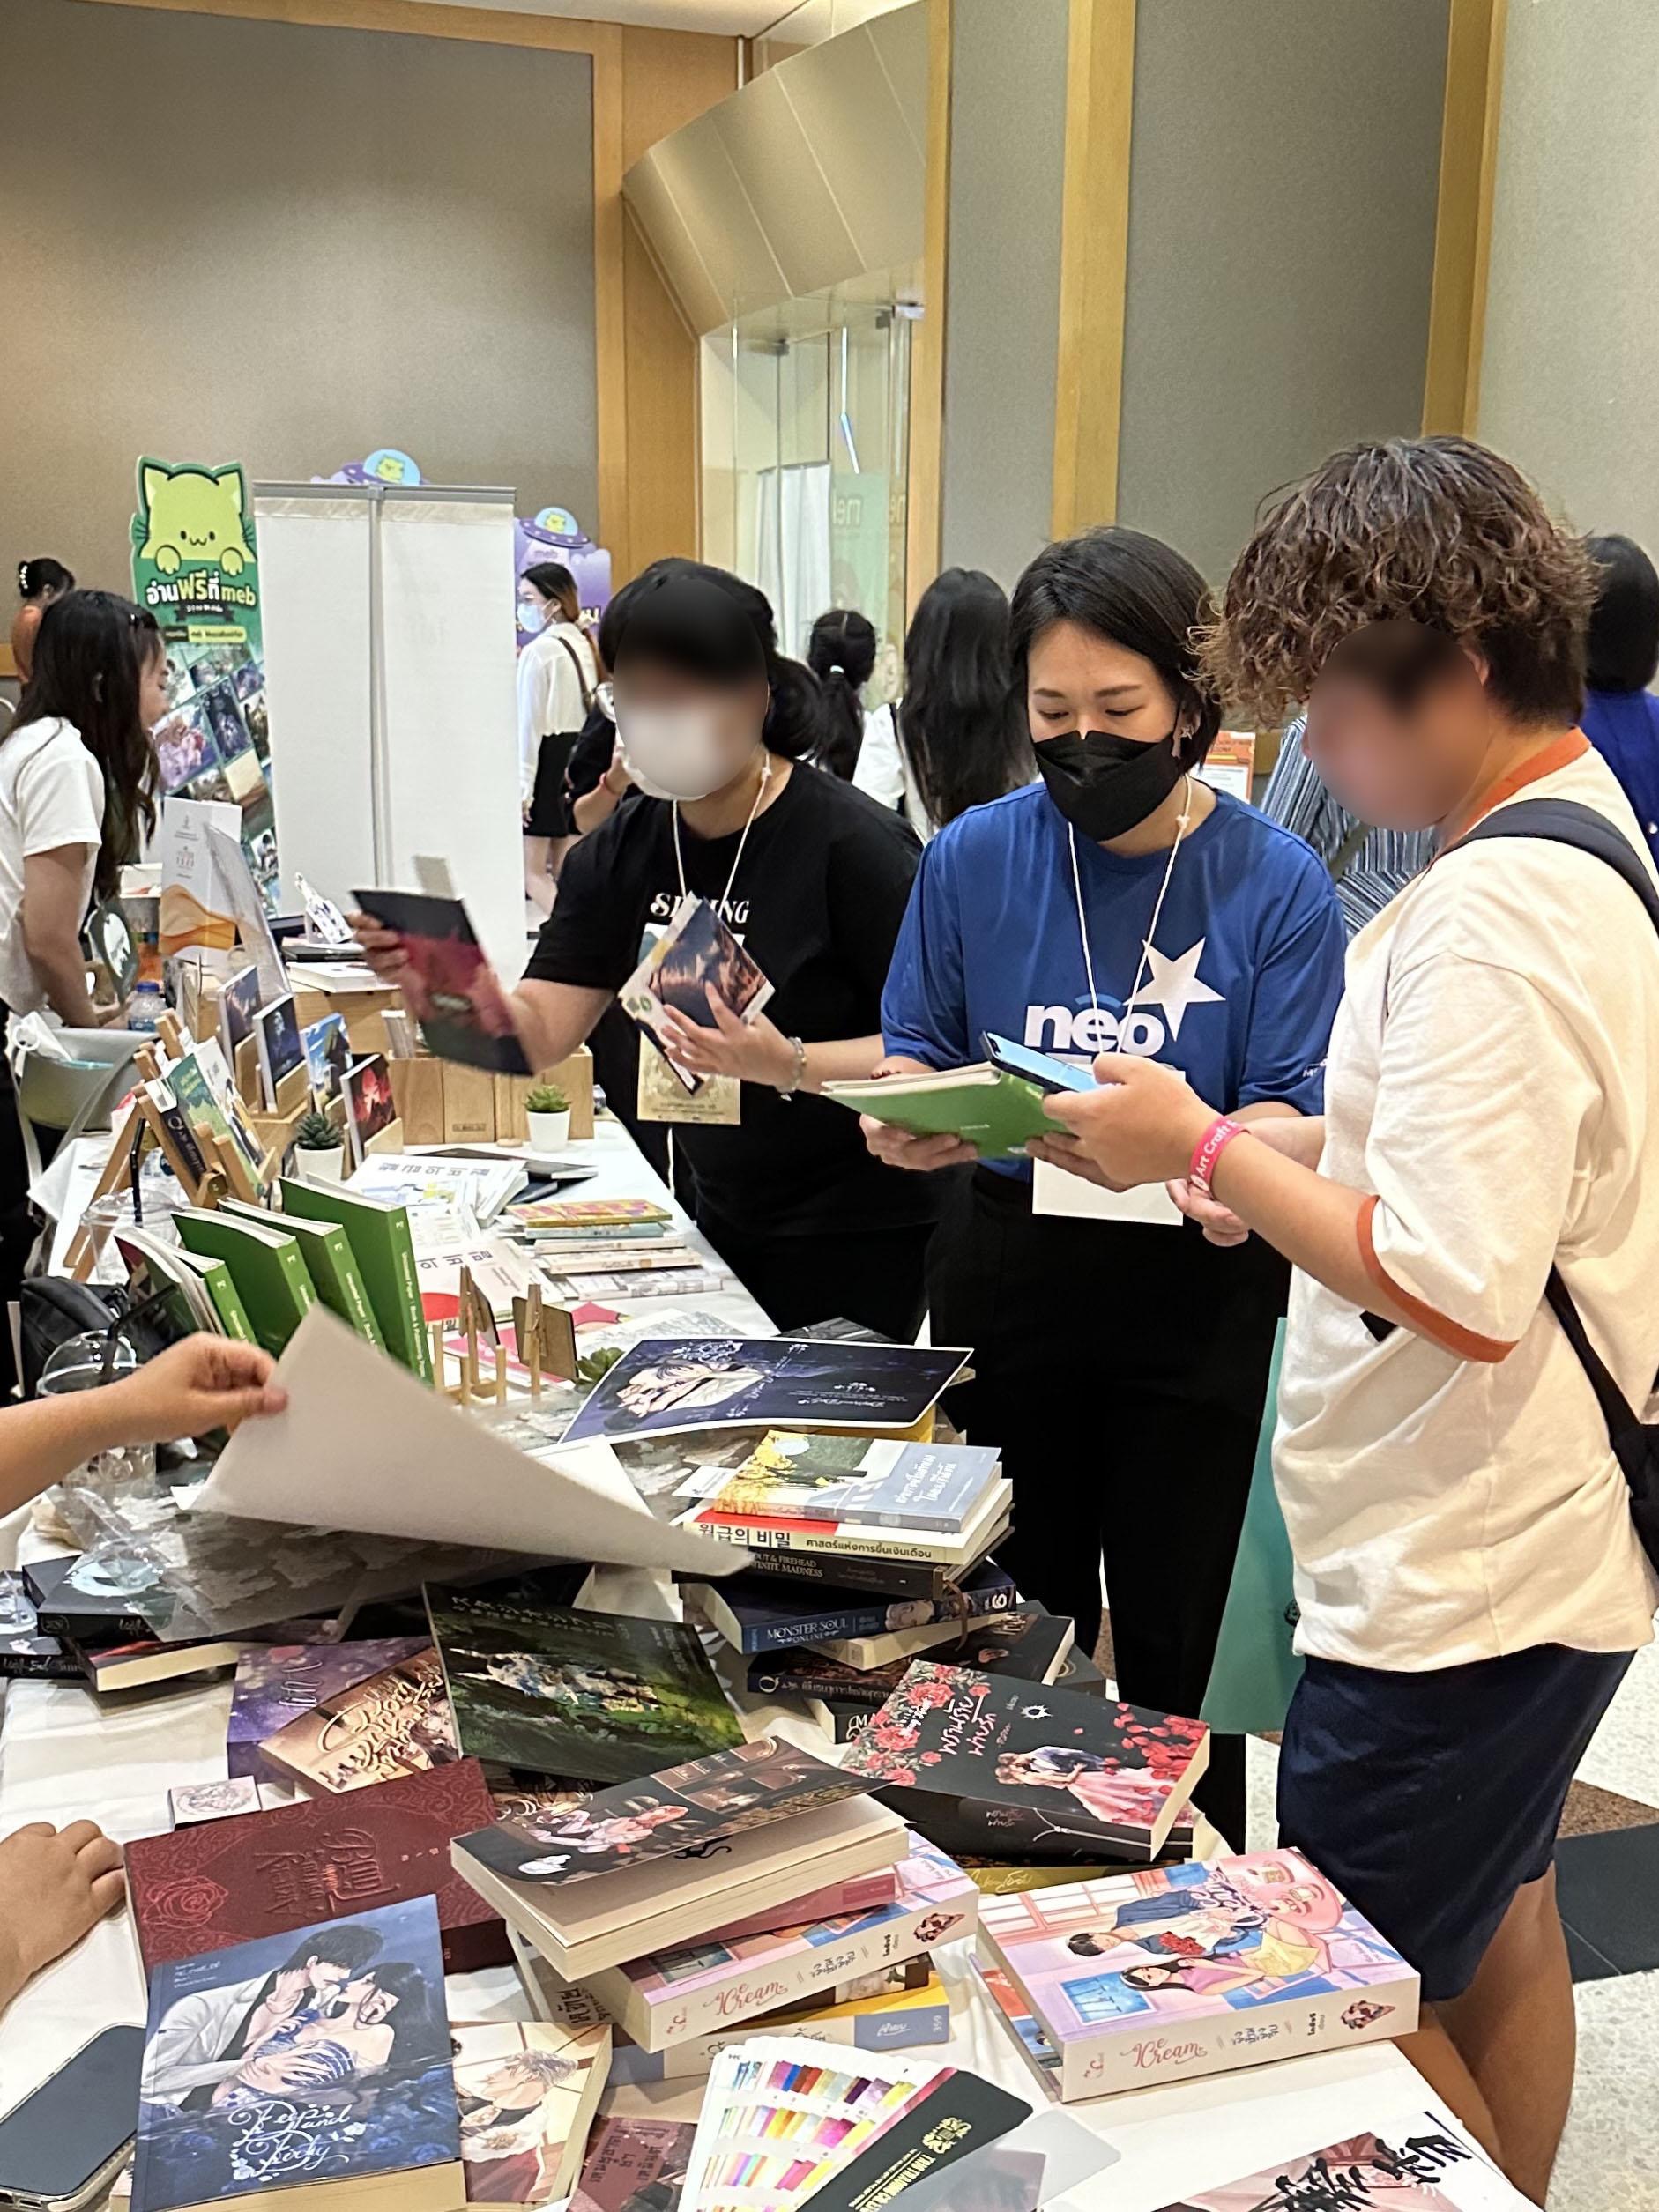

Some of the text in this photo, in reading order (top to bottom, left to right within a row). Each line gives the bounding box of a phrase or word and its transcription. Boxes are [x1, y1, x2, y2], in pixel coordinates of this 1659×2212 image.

[222, 586, 257, 605] meb
[1023, 1004, 1165, 1057] neo
[1195, 1125, 1230, 1176] Art Craft
[756, 1530, 791, 1549] 비밀
[781, 1564, 823, 1577] MADNESS
[767, 1622, 818, 1640] MONSTER
[818, 1617, 847, 1631] SOUL
[792, 1632, 825, 1644] ONLINE
[301, 2104, 353, 2129] and
